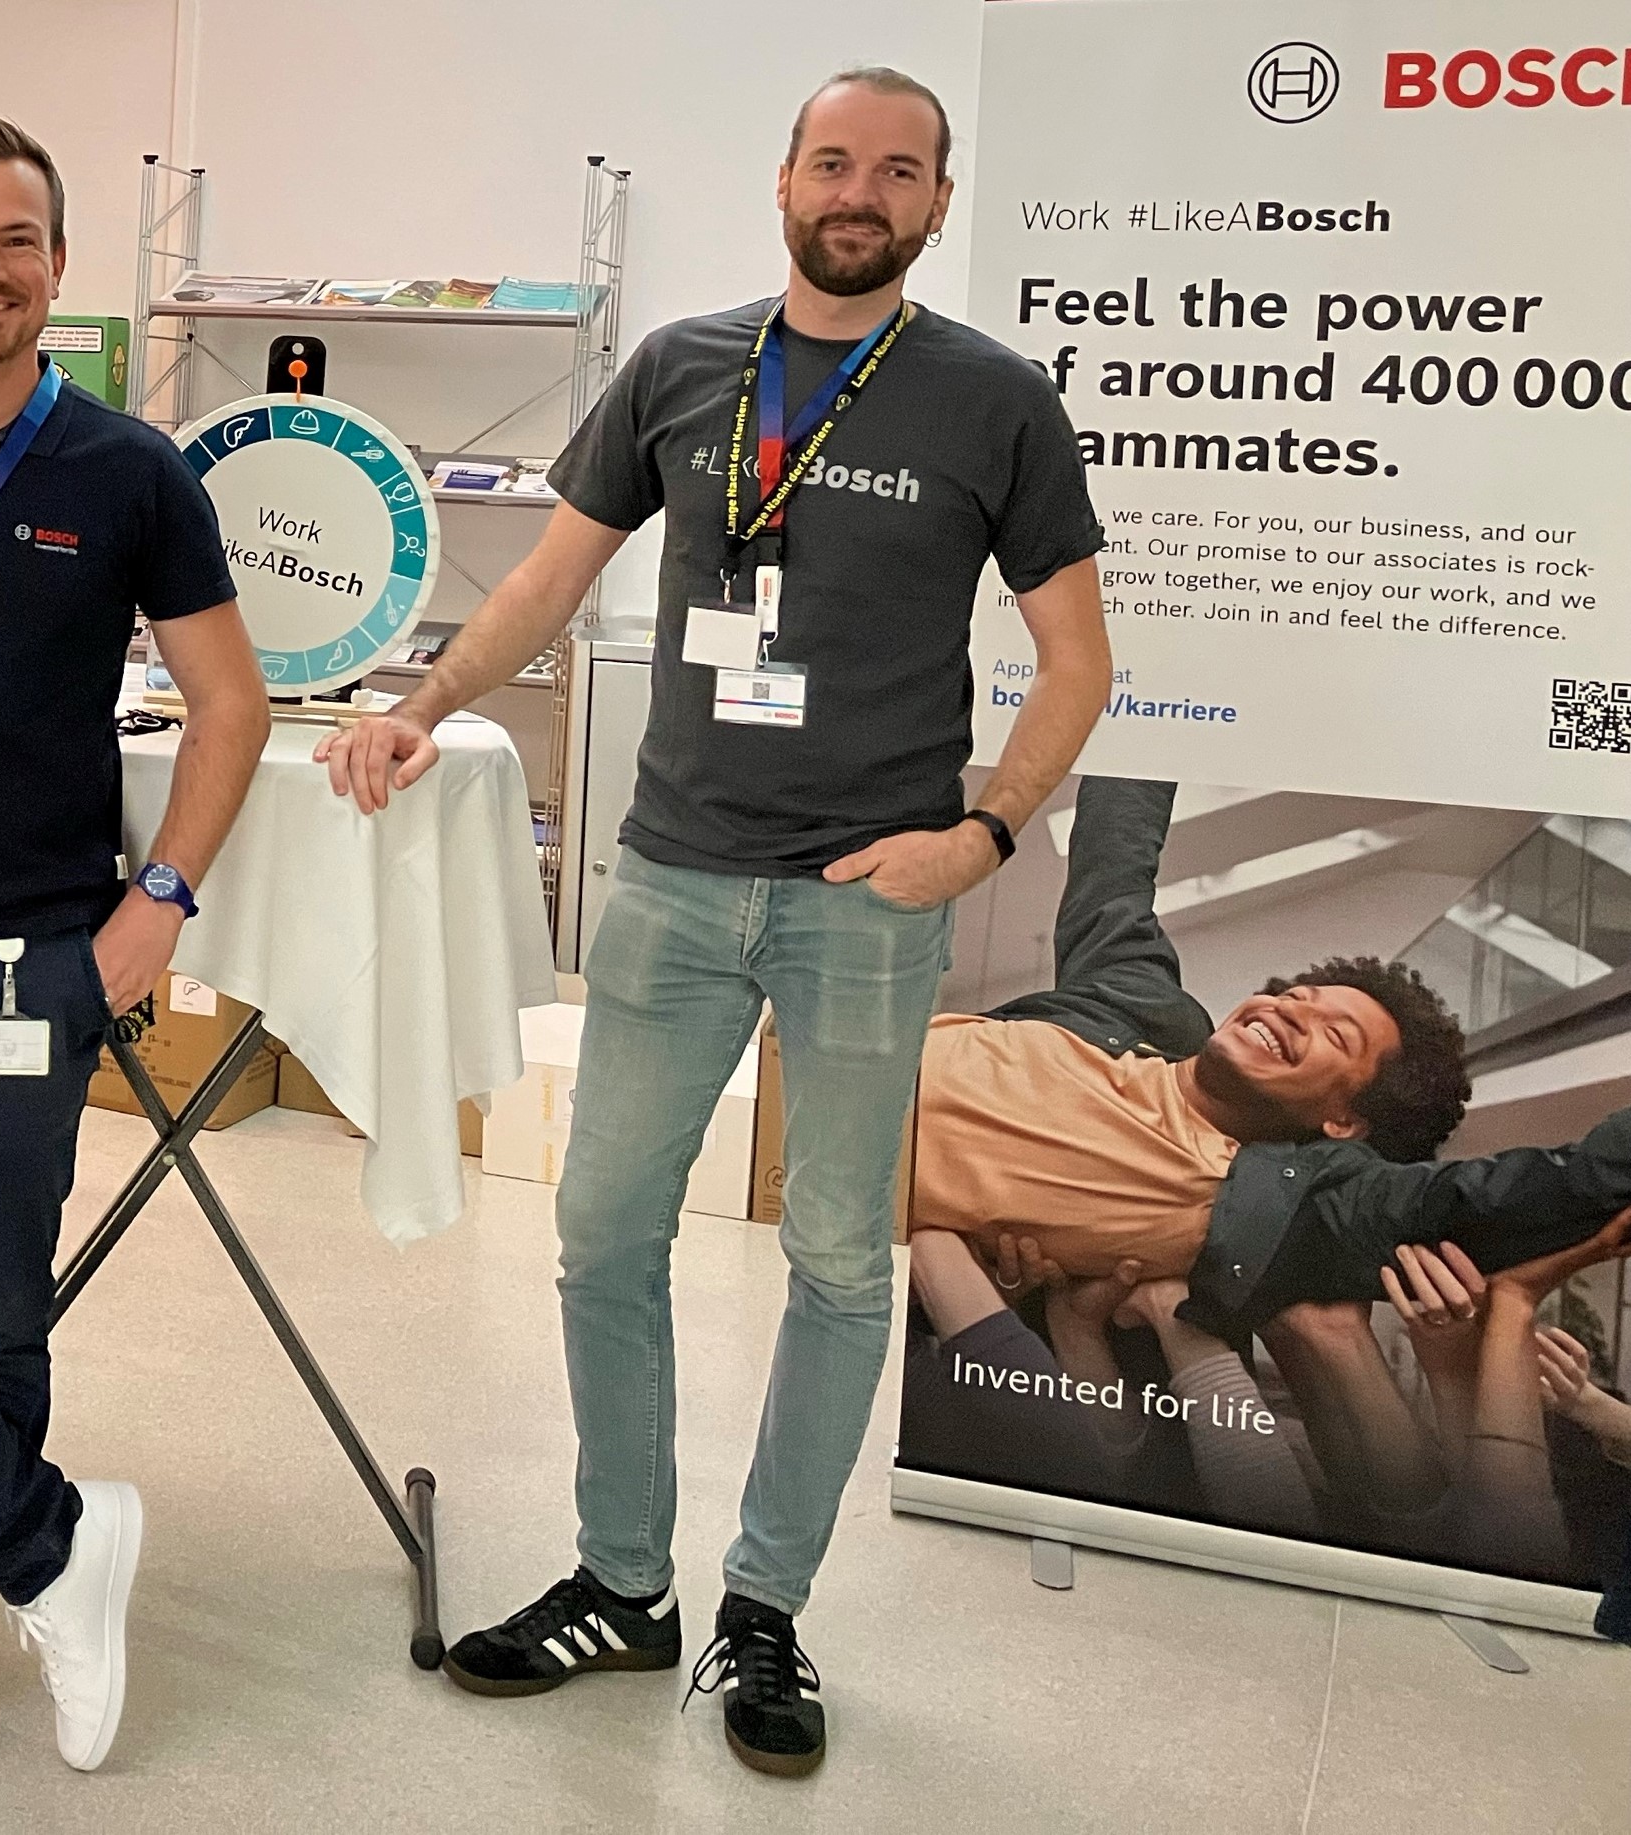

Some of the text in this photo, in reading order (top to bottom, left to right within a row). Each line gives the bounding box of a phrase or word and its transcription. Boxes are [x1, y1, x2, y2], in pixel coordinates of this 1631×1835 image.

[1384, 48, 1631, 109] BOSC
[1021, 200, 1390, 232] Work #LikeABosch
[1019, 277, 1543, 342] Feel the power
[851, 357, 878, 388] Lange
[873, 330, 896, 359] Nacht
[1026, 346, 1078, 394] f
[1099, 351, 1335, 402] around
[726, 395, 748, 535] Lange Nacht der Karriere
[1075, 430, 1399, 478] ammates.
[740, 420, 834, 540] Lange Nacht der Karriere
[36, 528, 79, 547] BOSCH
[259, 506, 322, 544] Work
[1112, 510, 1143, 525] we
[1151, 512, 1204, 527] care.
[1214, 510, 1251, 529] For
[1257, 516, 1303, 535] you,
[1314, 519, 1353, 534] our
[1361, 516, 1470, 543] business,
[1480, 523, 1525, 542] and
[1535, 529, 1577, 544] our
[223, 538, 364, 597] ikeABosch
[1148, 538, 1189, 557] Our
[1197, 543, 1286, 562] promise
[1295, 546, 1317, 564] to
[1327, 551, 1366, 565] our
[1373, 551, 1497, 573] associates
[1507, 554, 1525, 574] is
[1536, 558, 1595, 577] rock-
[1102, 570, 1596, 610] grow together, we enjoy our work, and we
[1133, 598, 1195, 619] other.
[1204, 602, 1250, 622] Join
[1260, 605, 1279, 624] in
[1288, 608, 1331, 626] and
[1340, 608, 1383, 630] feel
[1392, 612, 1430, 632] the
[1439, 615, 1566, 641] difference.
[992, 658, 1133, 684] App at
[953, 1352, 1276, 1435] Invented for life
